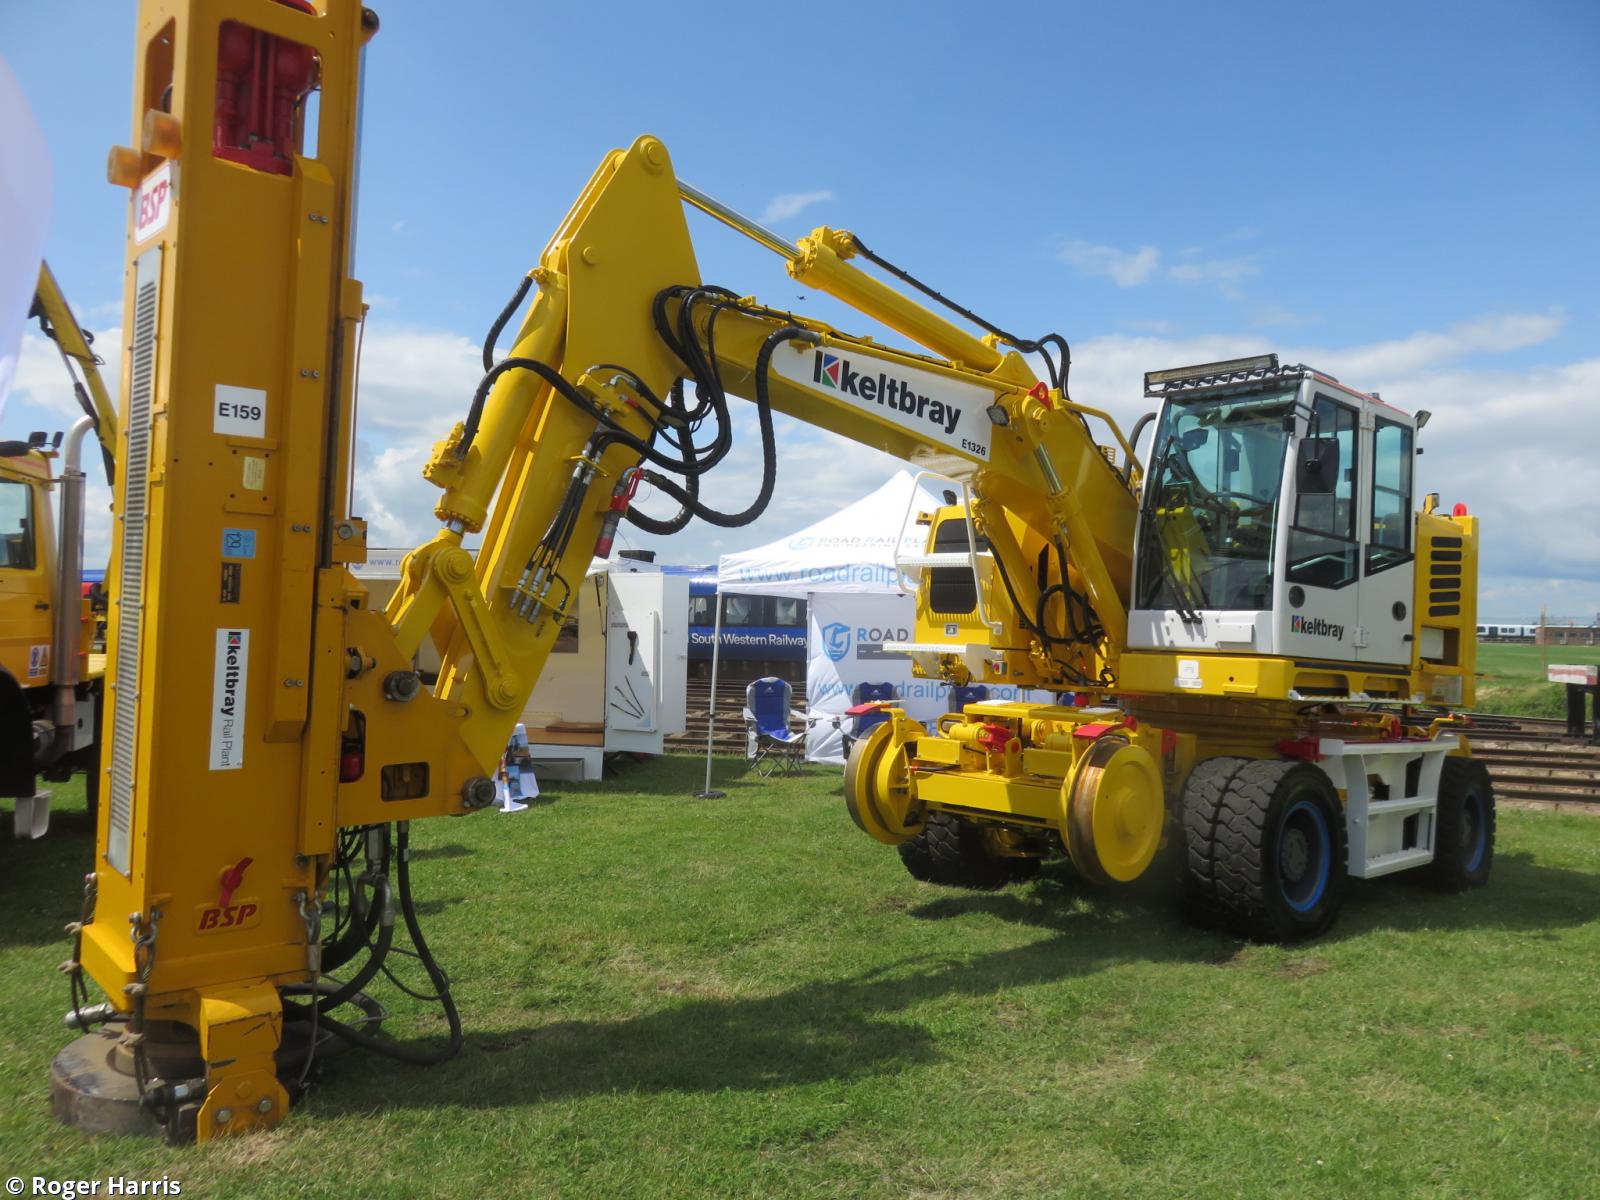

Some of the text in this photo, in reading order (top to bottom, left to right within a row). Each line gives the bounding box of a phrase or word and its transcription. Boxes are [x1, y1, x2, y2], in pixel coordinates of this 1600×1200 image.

[139, 179, 168, 231] BSP
[840, 359, 962, 434] keltbray
[218, 402, 262, 421] E159
[961, 438, 986, 456] E1326
[723, 632, 767, 646] Western
[768, 634, 807, 648] Railway
[856, 628, 909, 641] ROAD
[1300, 615, 1345, 642] keltbray
[219, 645, 241, 767] keltbray Rail Plant
[199, 903, 257, 930] BSP
